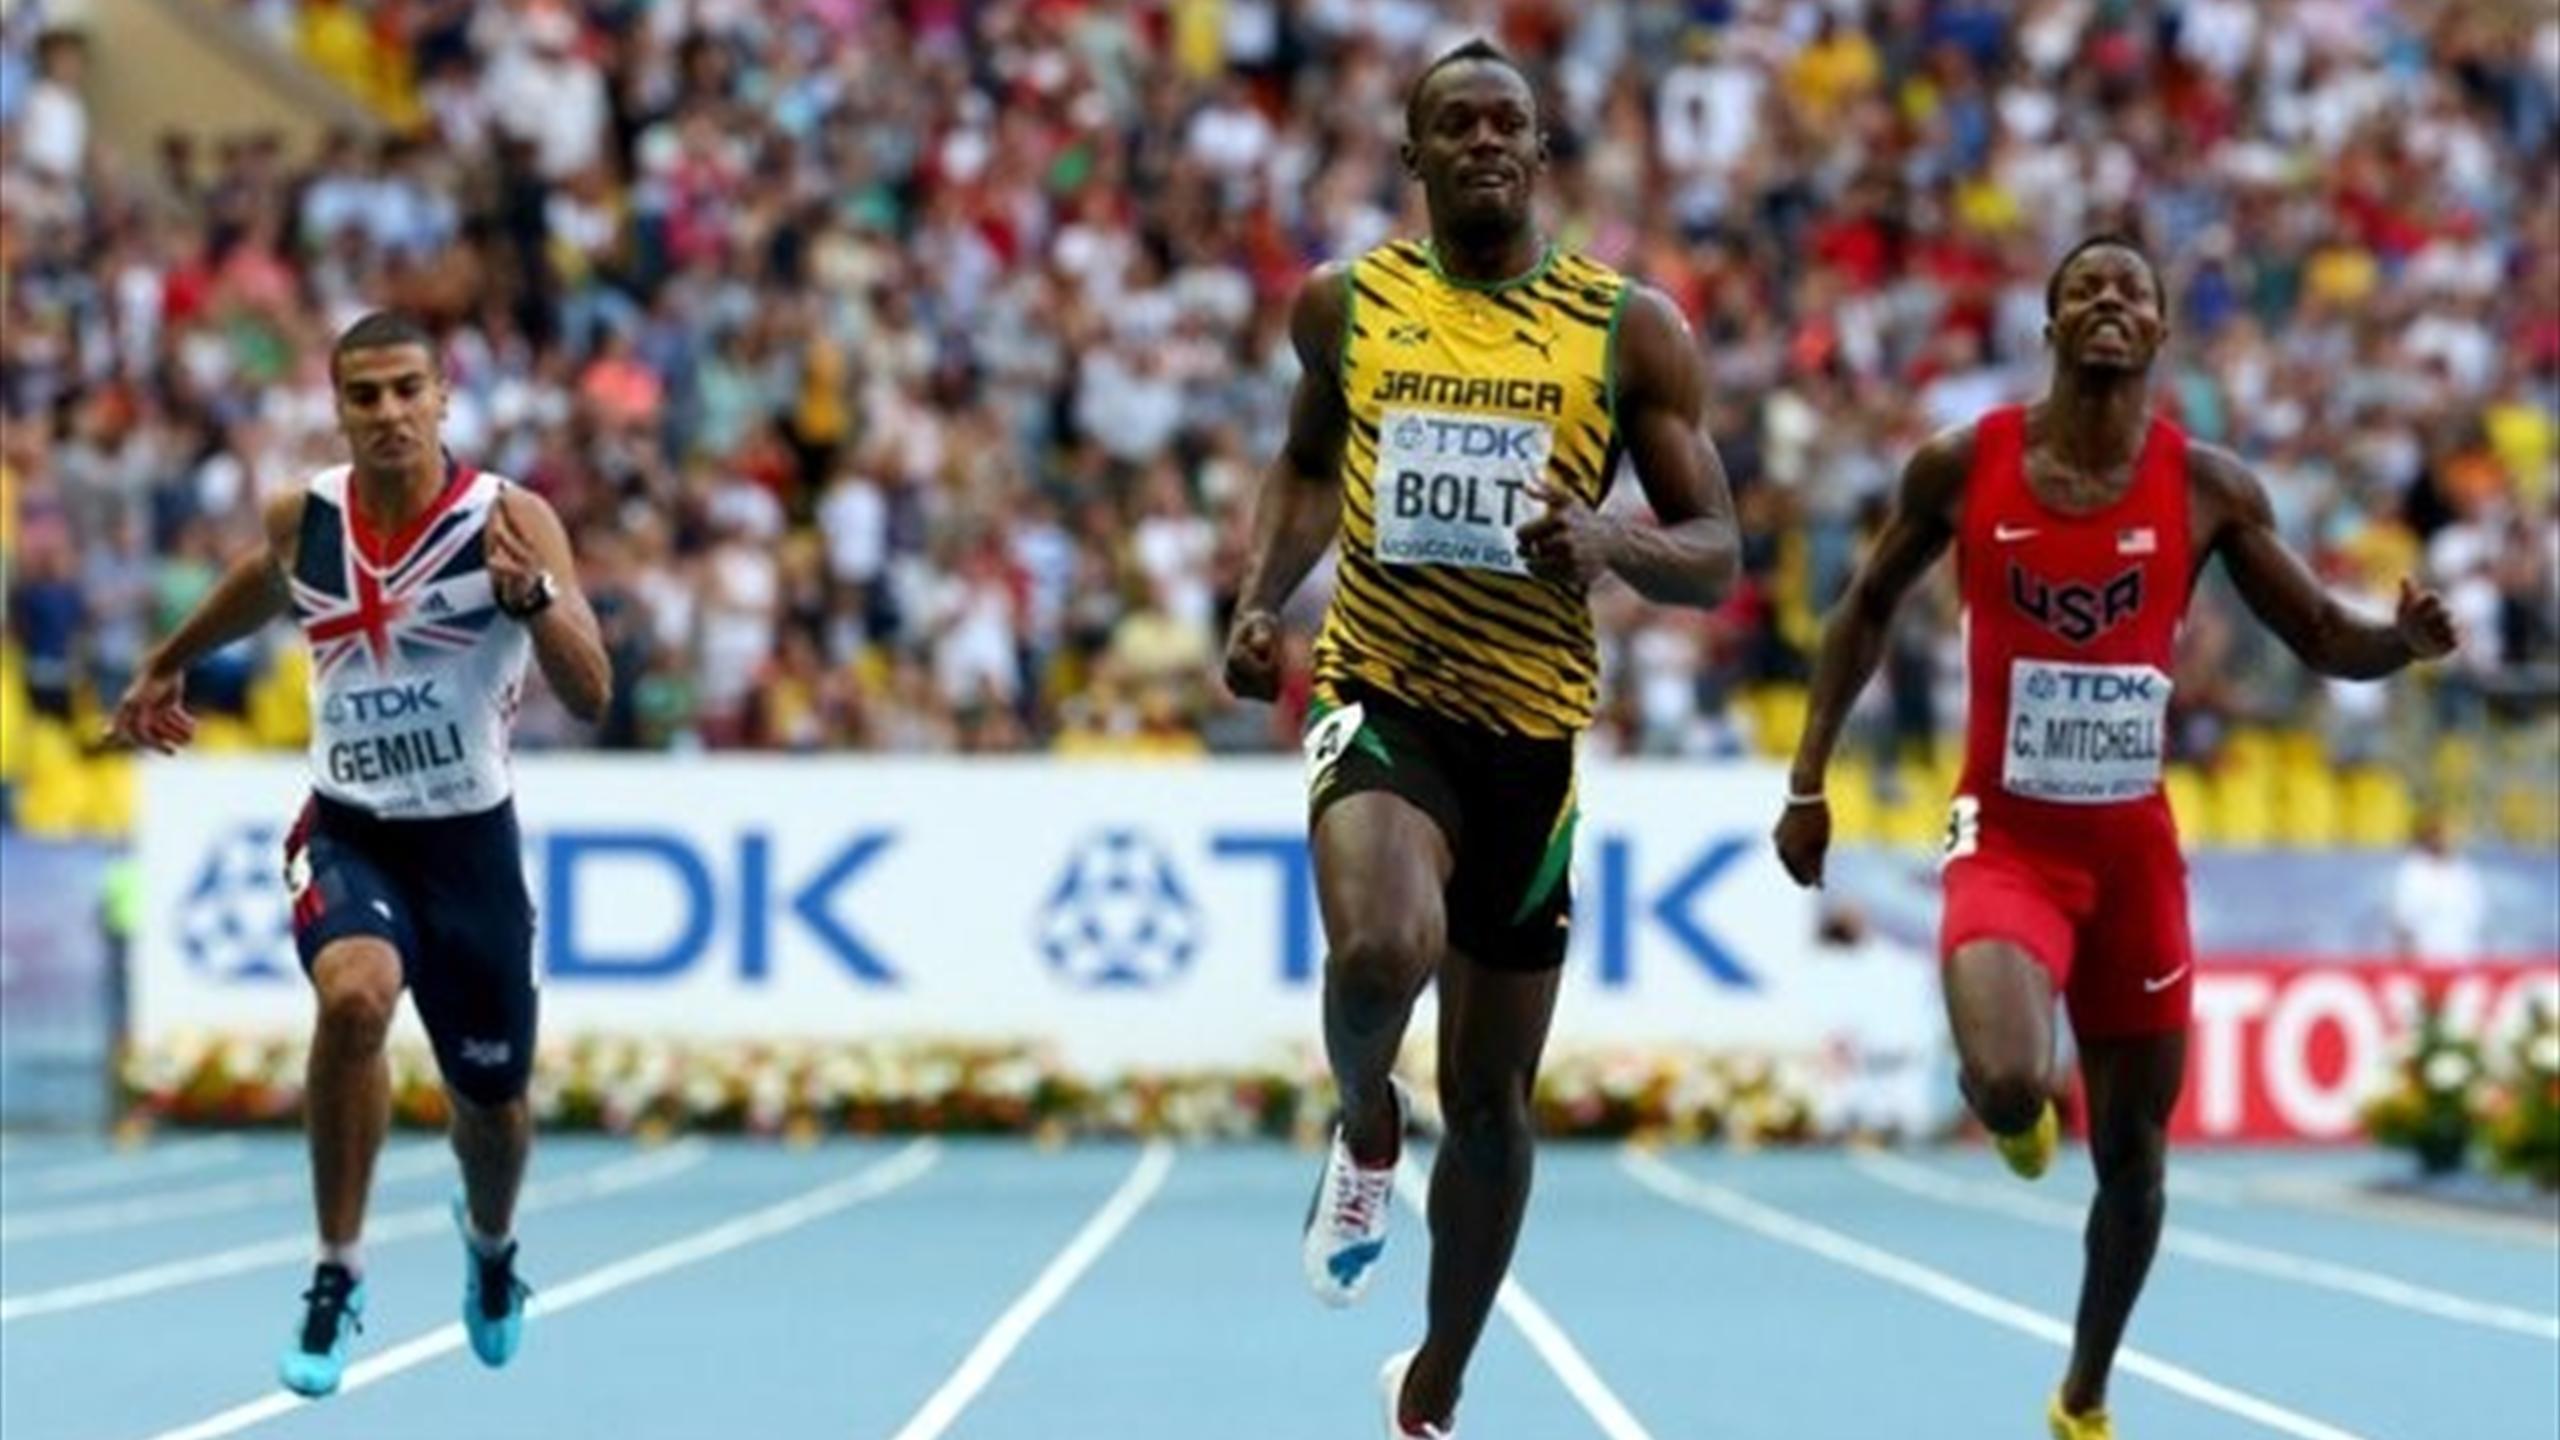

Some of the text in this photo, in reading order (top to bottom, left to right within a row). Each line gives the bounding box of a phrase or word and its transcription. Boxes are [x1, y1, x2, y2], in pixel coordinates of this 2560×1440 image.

[1372, 370, 1563, 415] JAMAICA
[1425, 418, 1535, 460] TDK
[1395, 470, 1526, 527] BOLT
[2008, 562, 2142, 645] USA
[346, 681, 442, 723] TDK
[2060, 673, 2152, 703] TDK
[329, 721, 465, 784] GEMILI
[2013, 714, 2156, 763] C. MITCHELL
[530, 832, 902, 982] DK
[1212, 832, 1760, 990] TK
